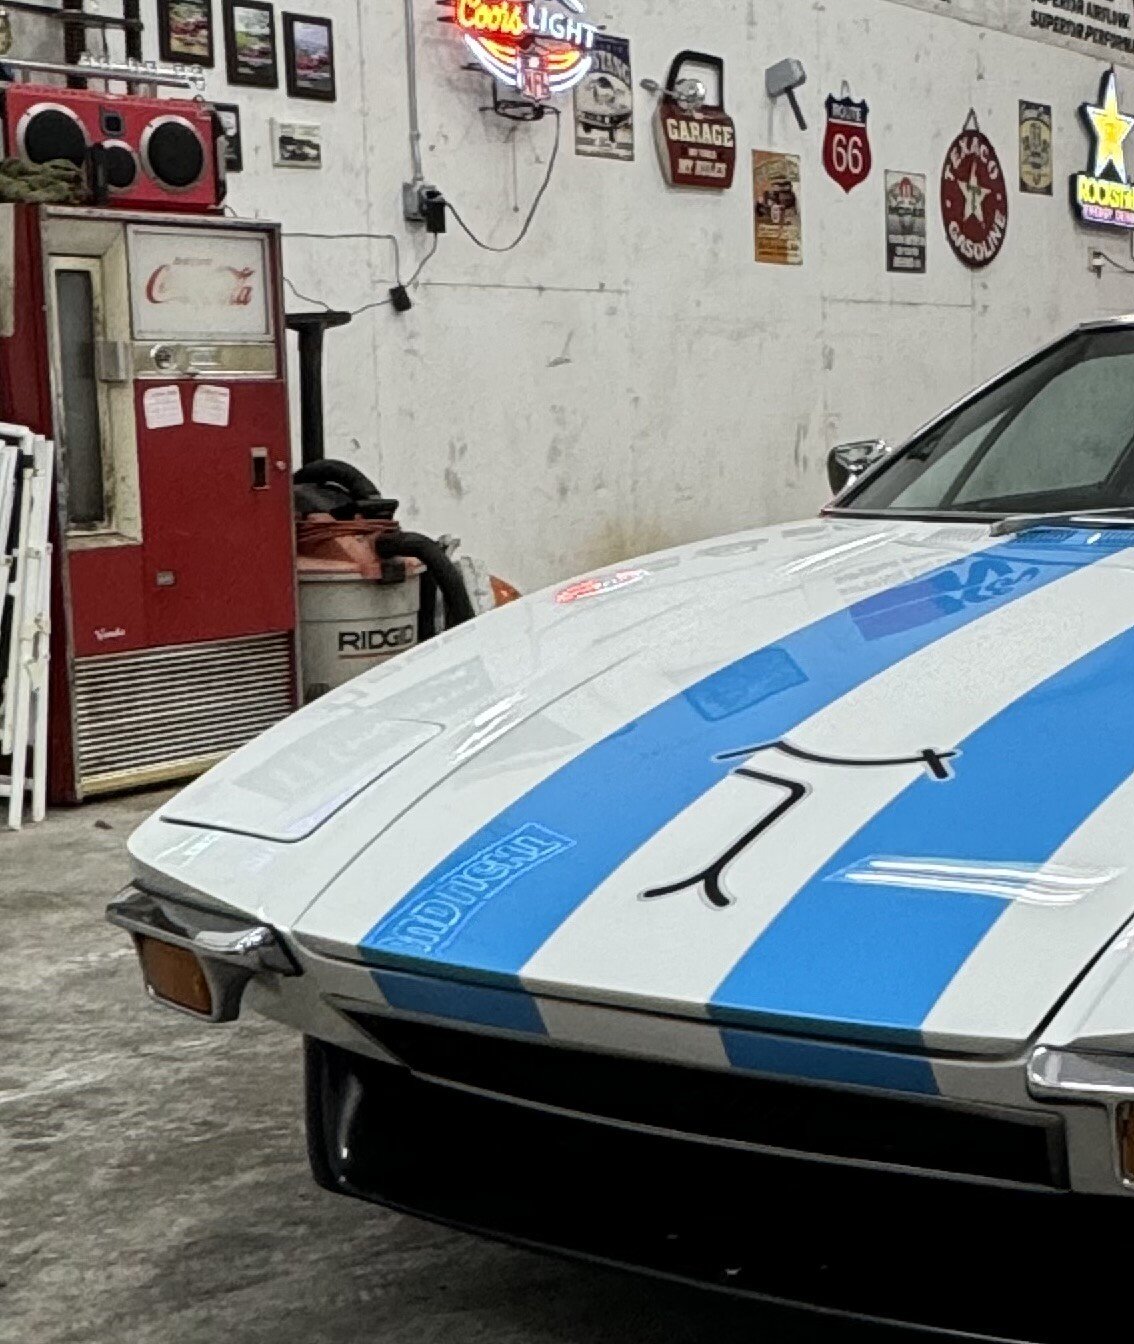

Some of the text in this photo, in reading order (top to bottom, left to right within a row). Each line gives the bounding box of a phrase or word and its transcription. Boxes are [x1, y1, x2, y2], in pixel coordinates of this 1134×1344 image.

[527, 2, 602, 49] LIGHT
[1030, 9, 1084, 39] SUPERIOR
[666, 117, 735, 148] GARAGE
[832, 133, 864, 174] 66
[945, 136, 999, 182] TEXACO
[948, 209, 1006, 262] GASOLINE
